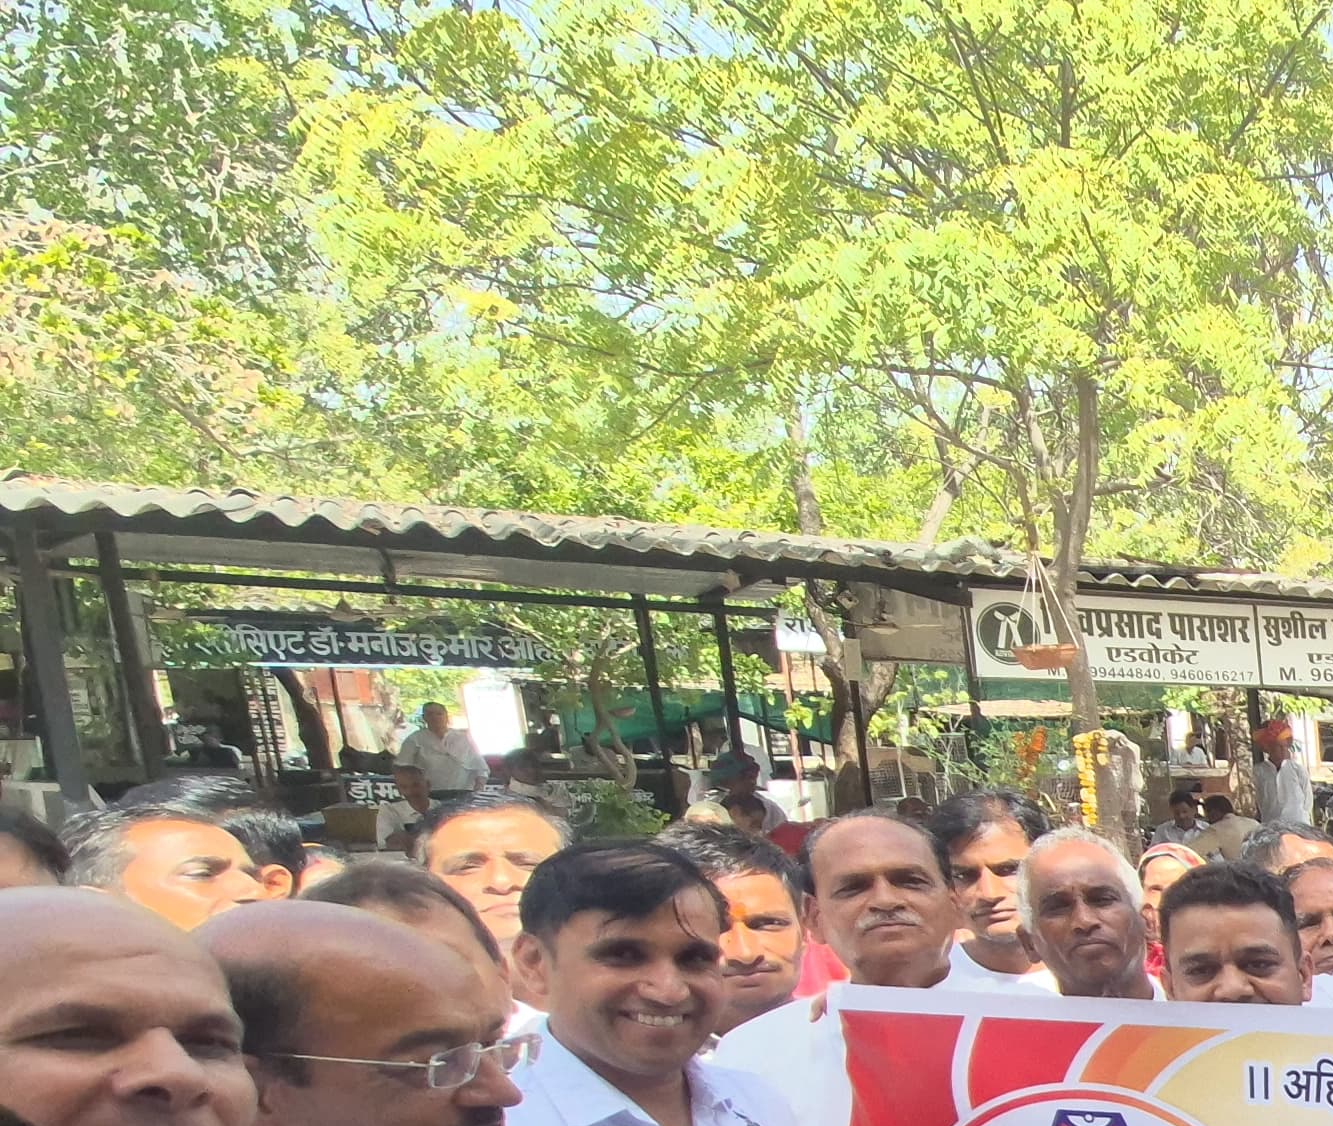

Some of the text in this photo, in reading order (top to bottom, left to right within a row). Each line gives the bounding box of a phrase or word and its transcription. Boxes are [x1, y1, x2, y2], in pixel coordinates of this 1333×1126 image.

[1167, 611, 1250, 643] पाराशर
[1262, 610, 1327, 646] सुशील
[1105, 642, 1200, 665] एडवोकेट
[1170, 668, 1254, 682] 9460616217
[1279, 667, 1303, 682] M.
